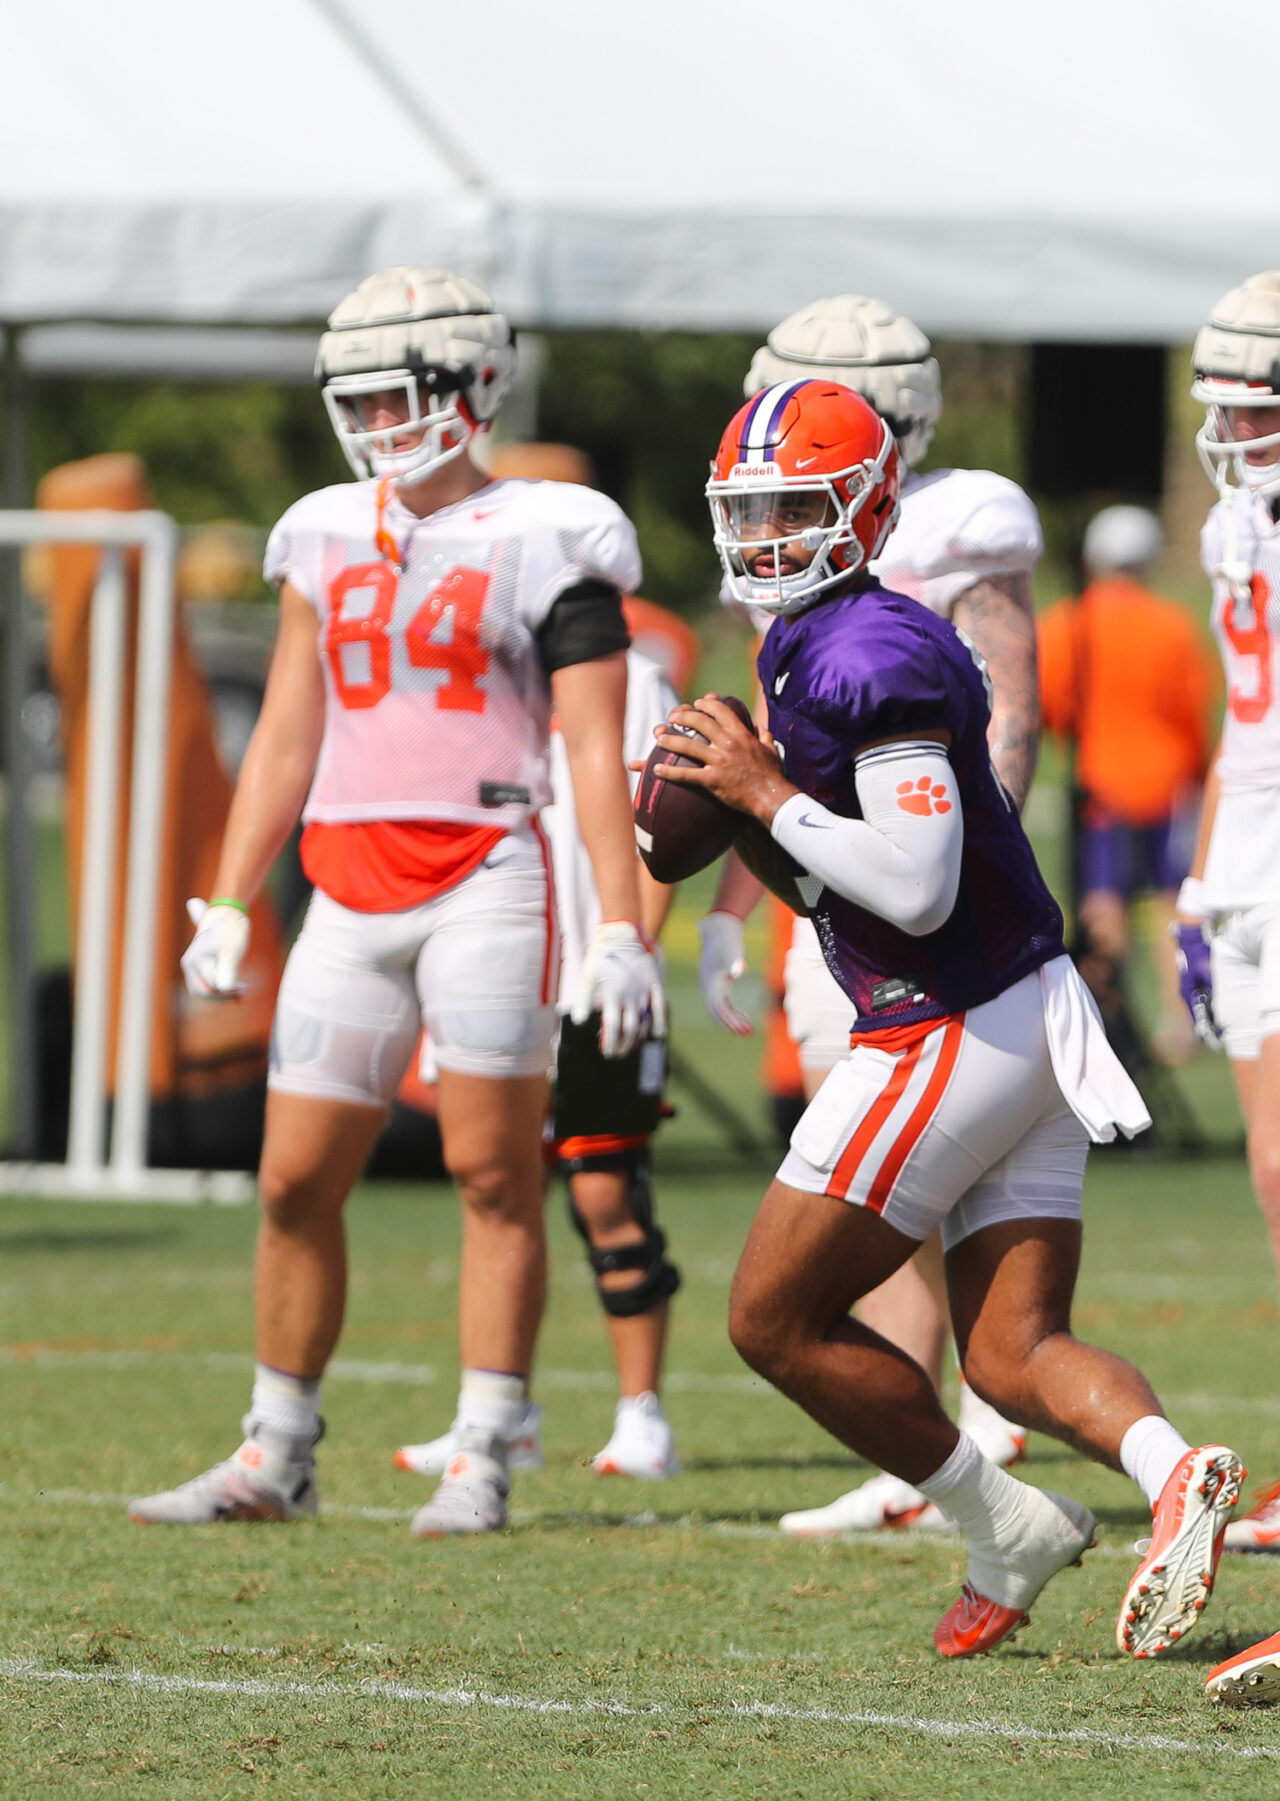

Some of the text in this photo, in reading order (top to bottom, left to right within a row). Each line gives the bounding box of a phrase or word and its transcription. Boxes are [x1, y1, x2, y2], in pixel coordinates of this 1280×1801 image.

[734, 466, 774, 477] Riddell
[323, 561, 491, 715] 84
[1222, 572, 1272, 724] 9
